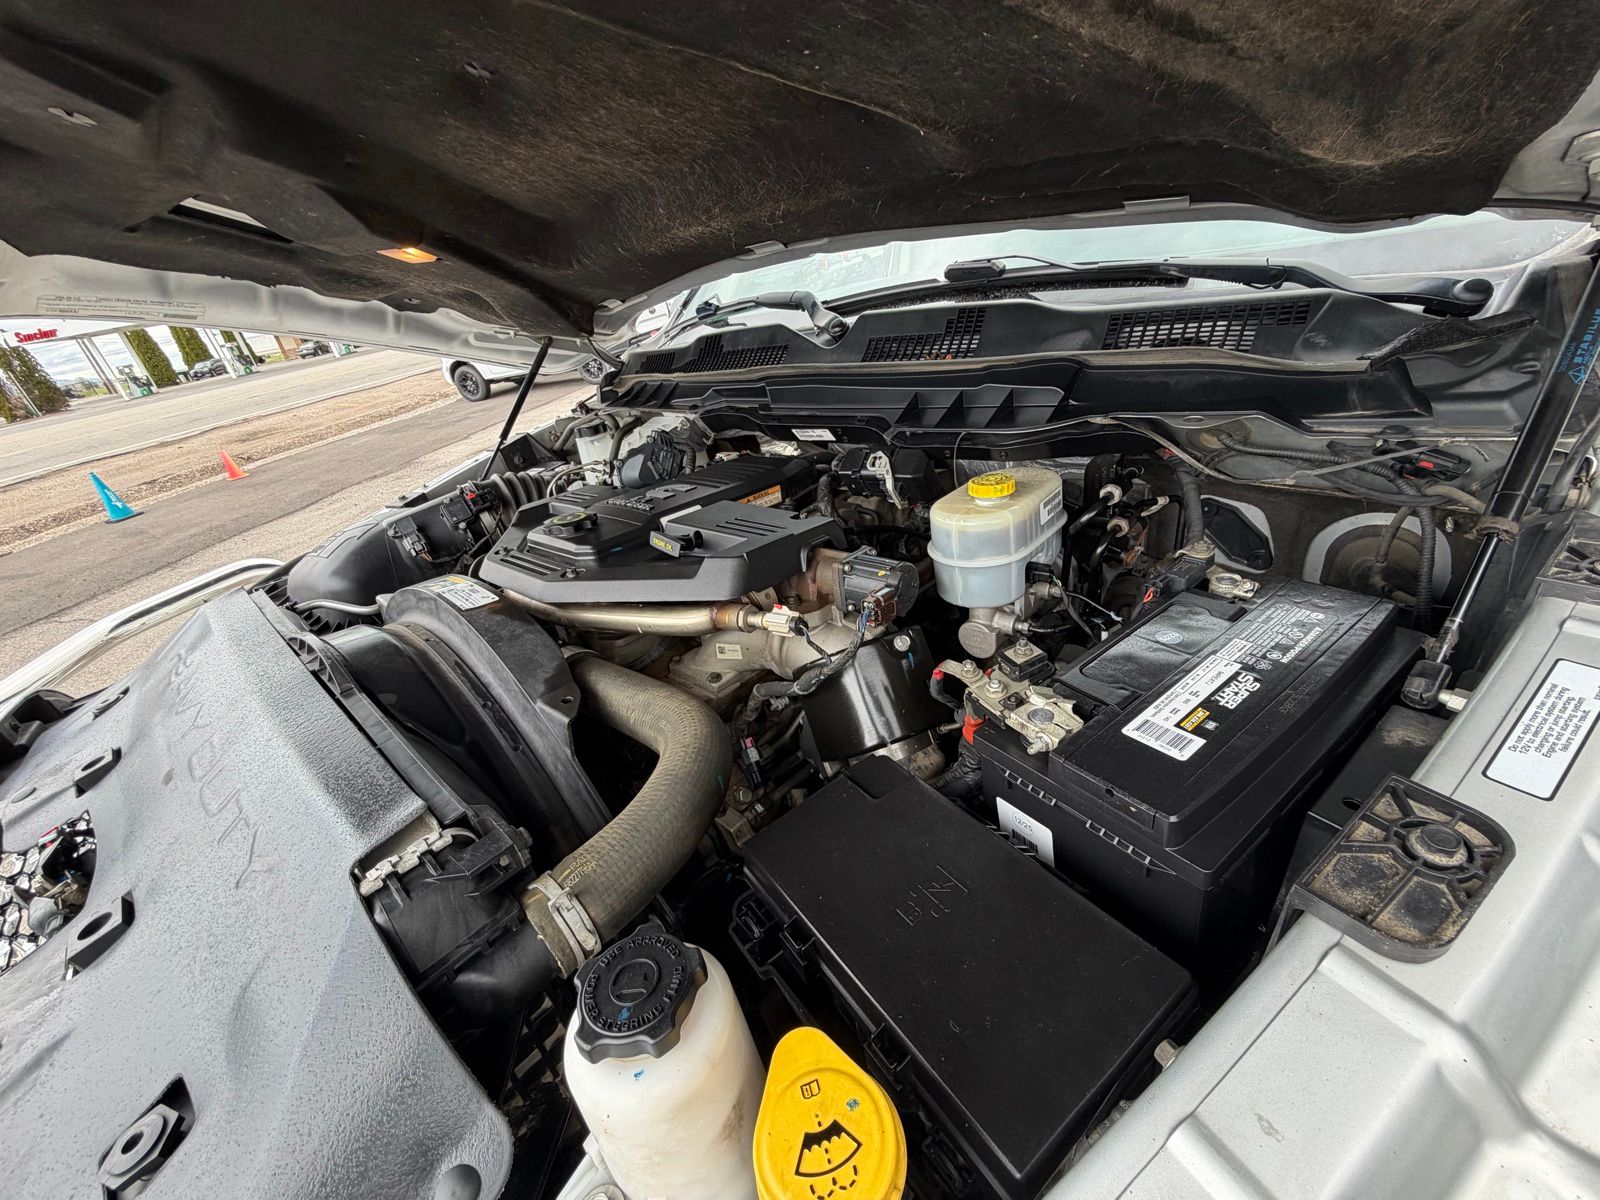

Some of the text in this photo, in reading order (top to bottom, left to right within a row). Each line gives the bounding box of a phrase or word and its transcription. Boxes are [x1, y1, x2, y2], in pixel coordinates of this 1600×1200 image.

[14, 328, 58, 343] Sinclair
[653, 537, 666, 549] ENGINE
[1217, 672, 1253, 706] START
[1222, 680, 1261, 710] SUPER
[1535, 701, 1545, 713] than
[1528, 711, 1538, 725] more
[1520, 722, 1534, 737] apply
[1571, 720, 1581, 738] could
[1508, 742, 1519, 753] Do
[1516, 735, 1525, 745] not
[1518, 742, 1532, 755] 12V
[1527, 735, 1536, 745] to
[1541, 738, 1558, 759] Engine
[1555, 728, 1565, 742] and
[1013, 815, 1033, 832] 12/25
[600, 936, 680, 968] USE APPROVED
[584, 966, 683, 1032] POWER STEERING FLUID
